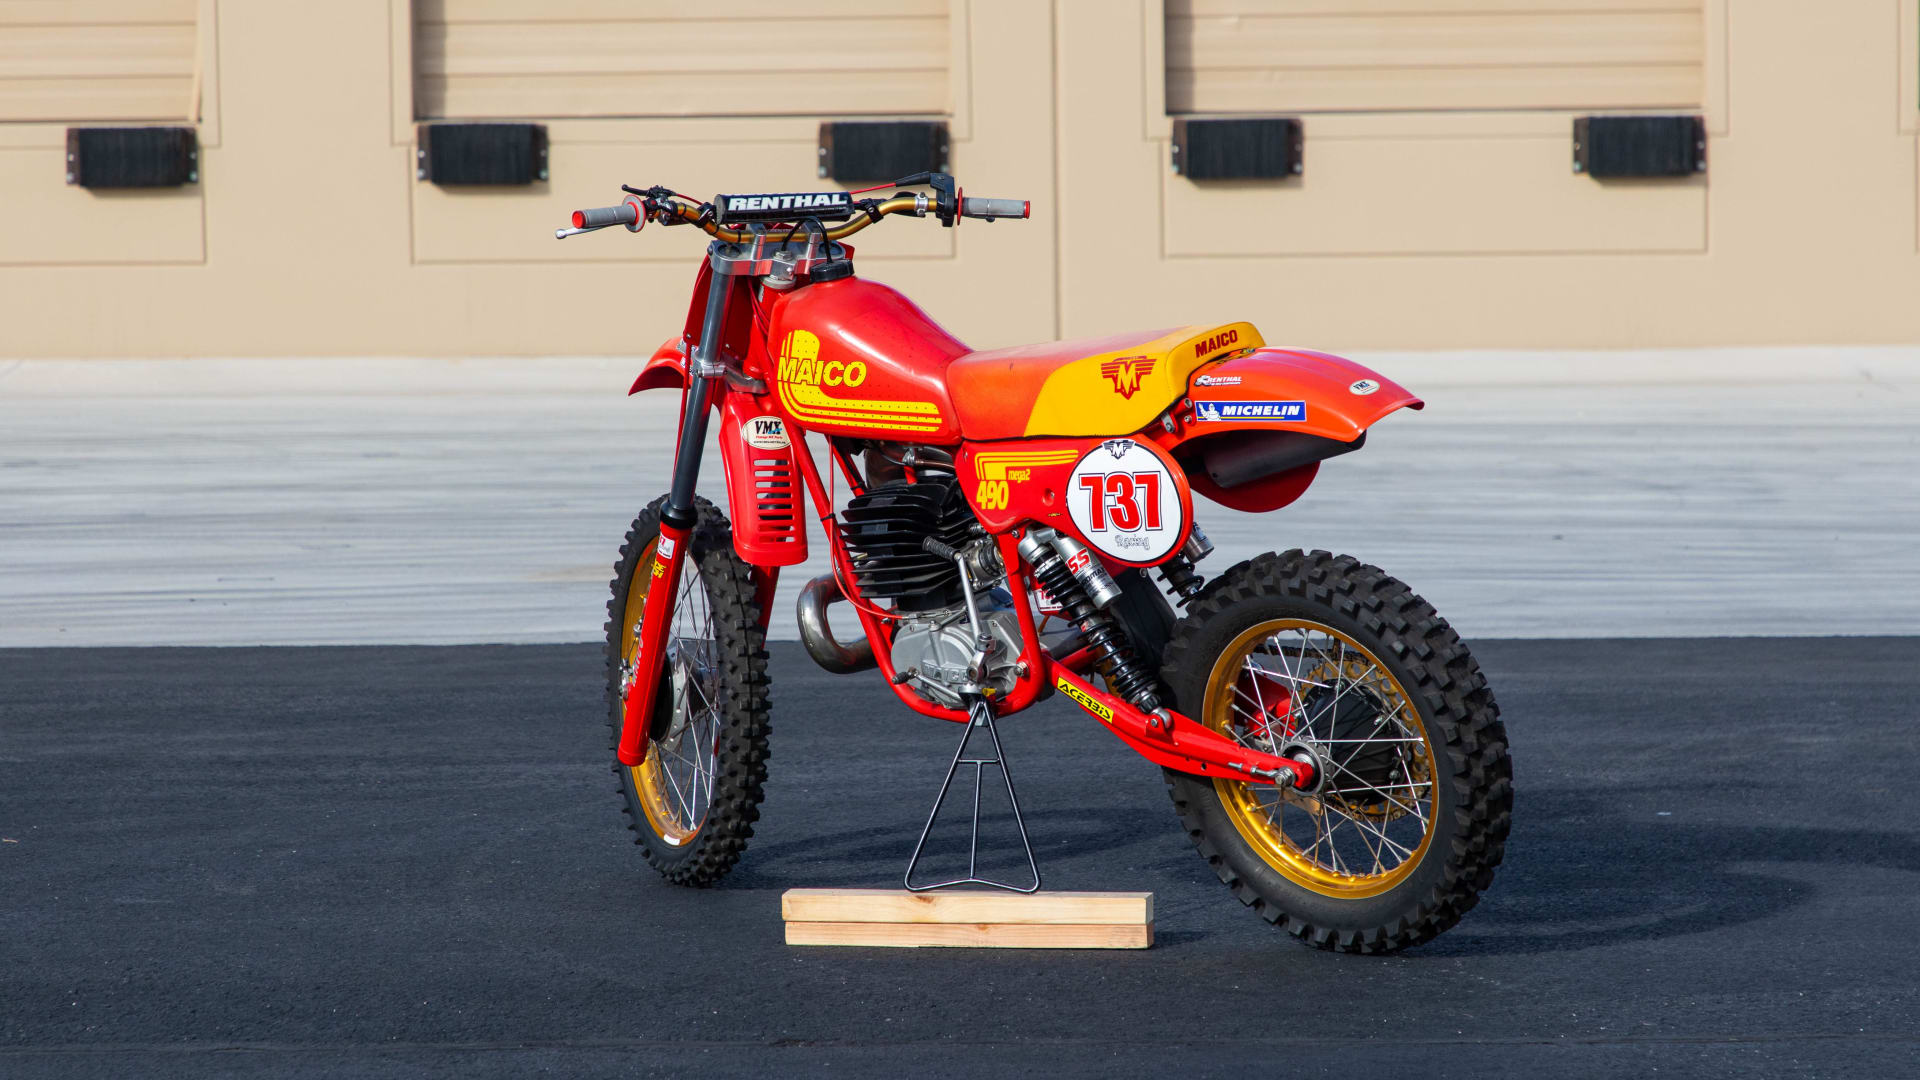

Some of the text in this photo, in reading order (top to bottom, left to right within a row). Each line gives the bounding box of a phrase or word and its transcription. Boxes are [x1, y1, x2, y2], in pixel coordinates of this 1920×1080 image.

[728, 194, 848, 211] RENTHAL
[1195, 330, 1238, 358] MAICO
[777, 356, 867, 388] MAICO
[1221, 405, 1301, 416] MICHELIN
[755, 421, 783, 434] VMX
[976, 480, 1009, 510] 490
[1078, 471, 1163, 532] 737
